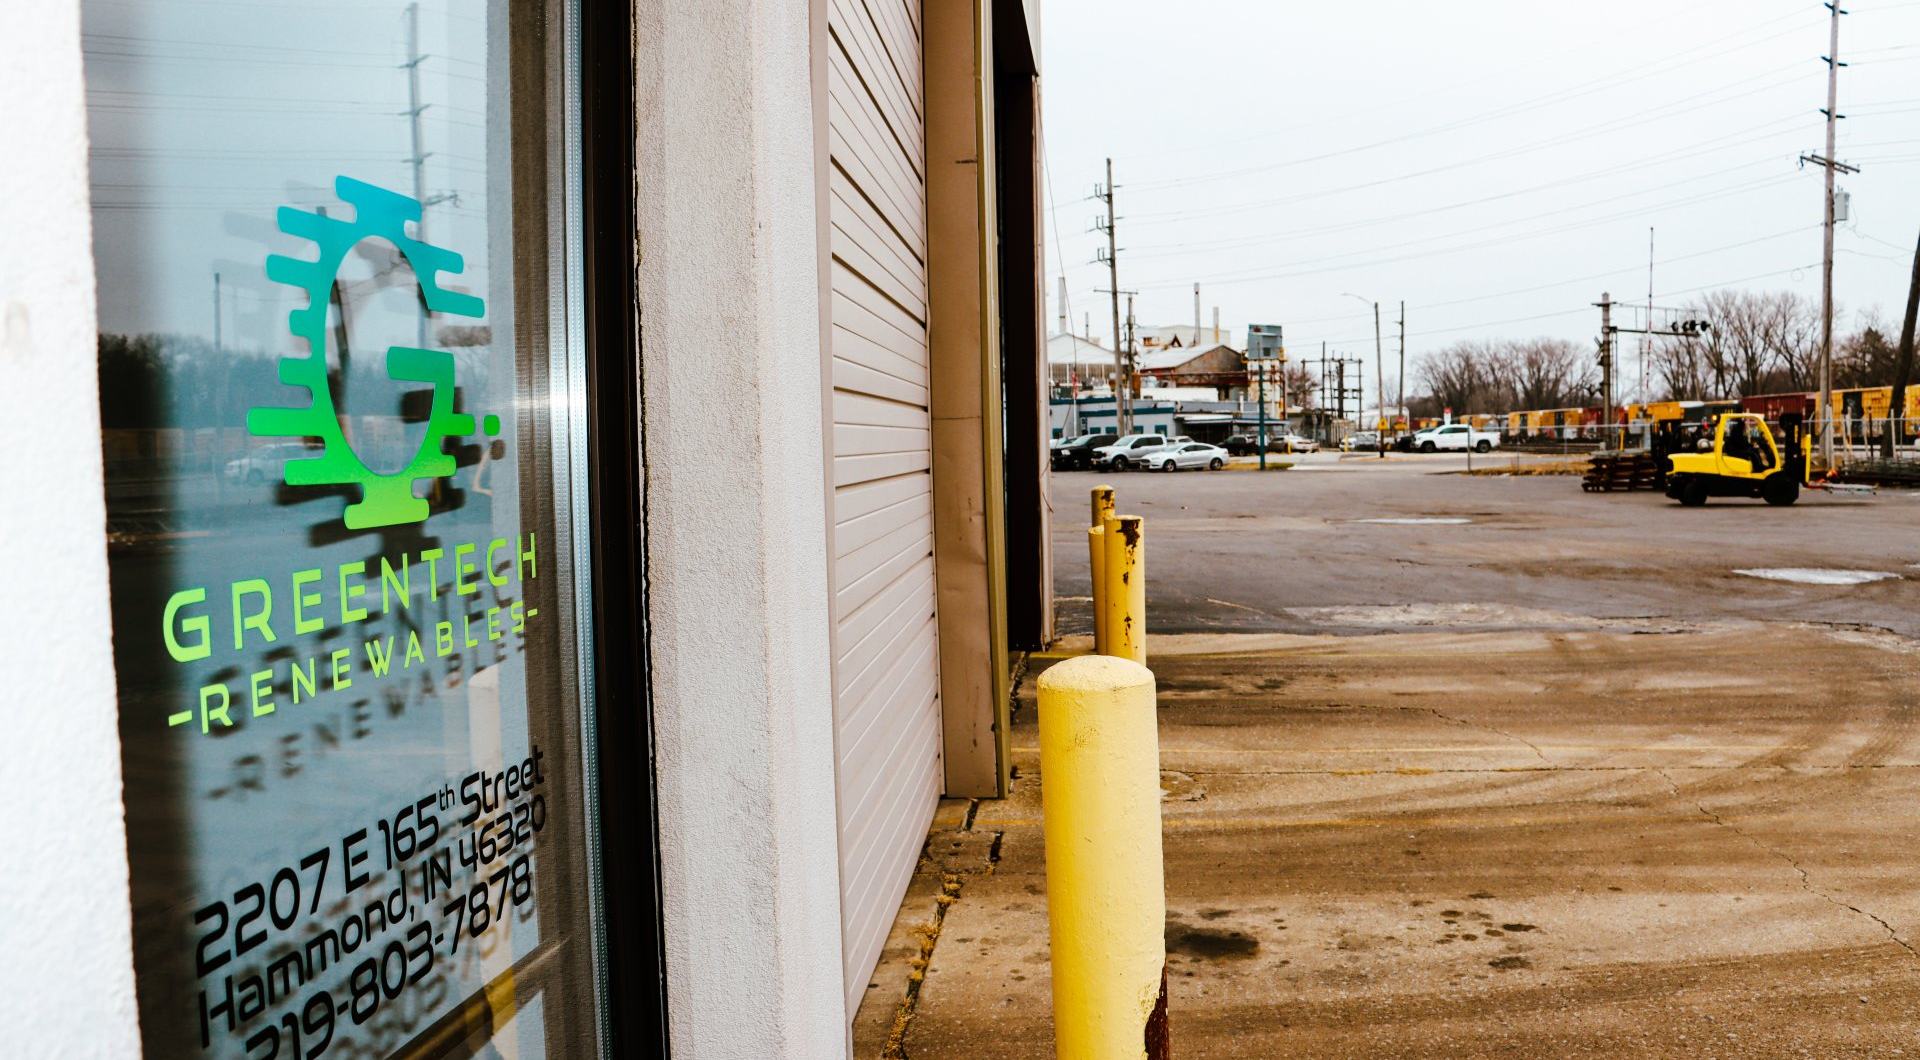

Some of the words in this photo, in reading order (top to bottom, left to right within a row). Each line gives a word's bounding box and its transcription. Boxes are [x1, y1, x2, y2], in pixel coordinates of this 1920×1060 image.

[163, 532, 537, 663] GREENTECH
[195, 846, 331, 979] 2207
[342, 827, 370, 894] E
[377, 783, 456, 871] 165th
[460, 744, 545, 828] Street
[199, 869, 416, 1049] Hammond,
[422, 846, 453, 905] IN
[458, 793, 546, 874] 46320
